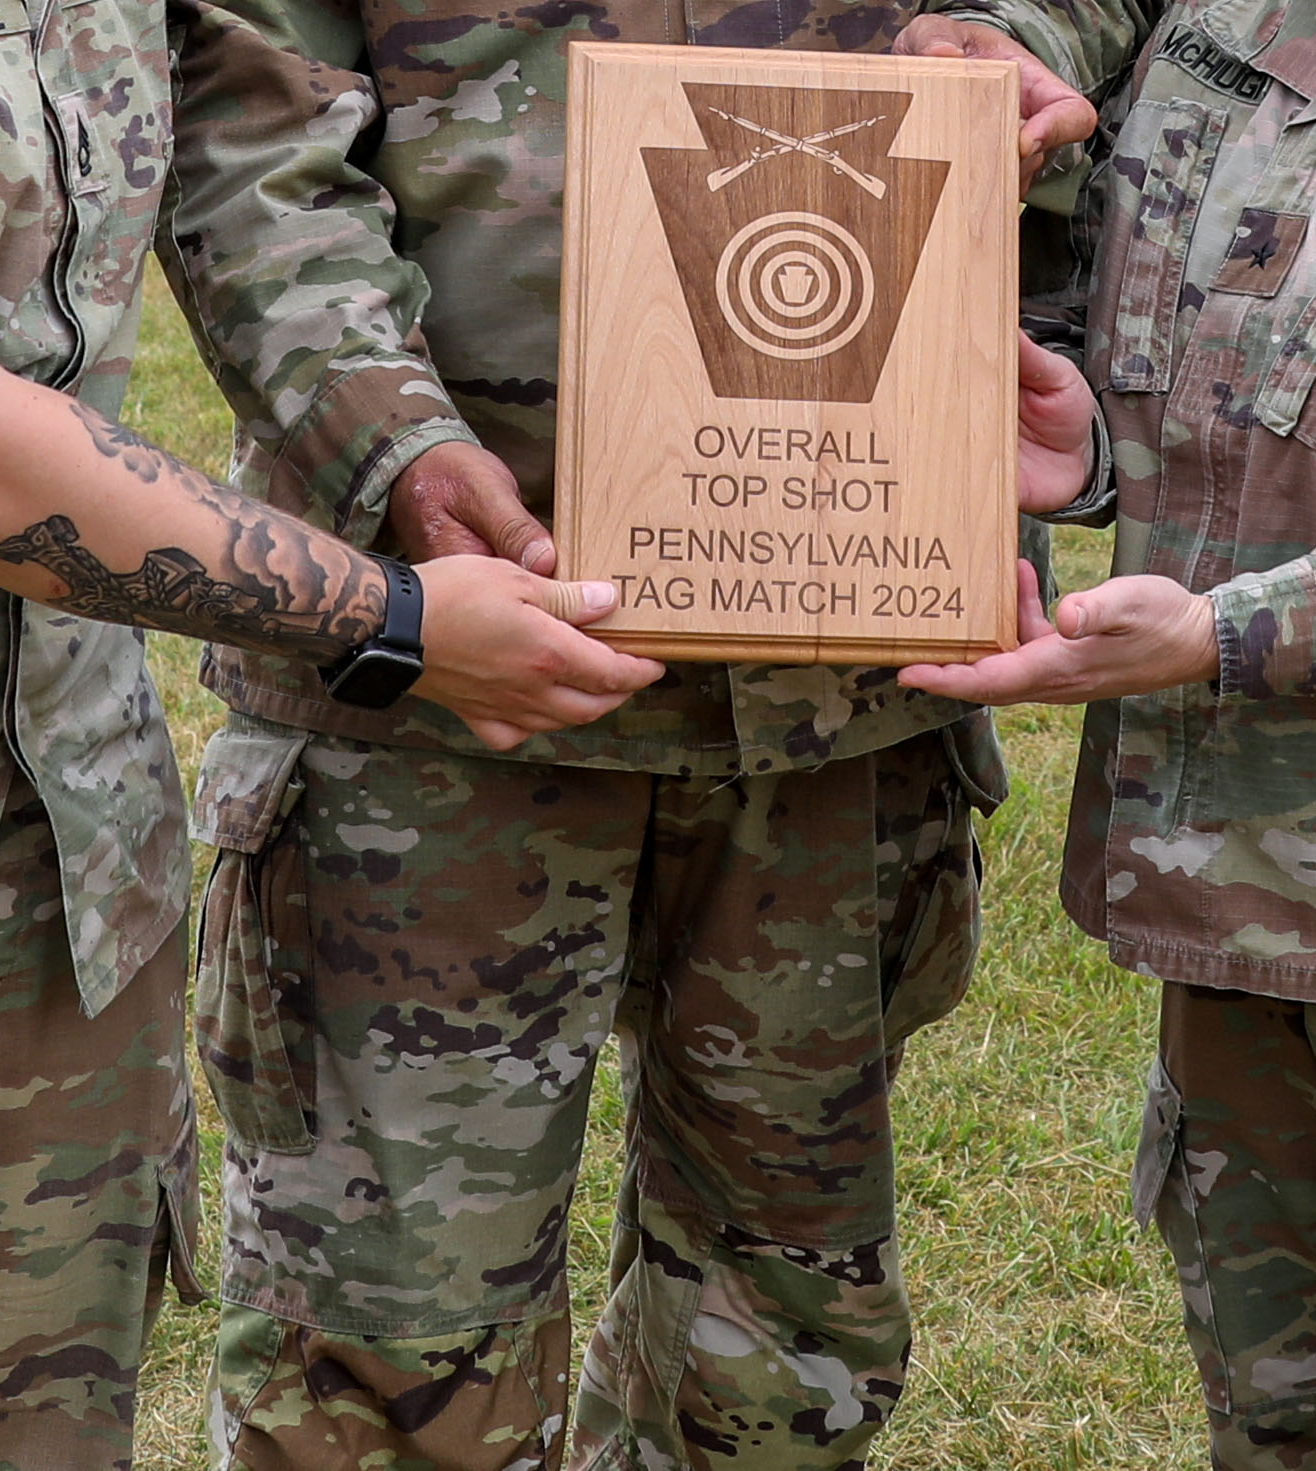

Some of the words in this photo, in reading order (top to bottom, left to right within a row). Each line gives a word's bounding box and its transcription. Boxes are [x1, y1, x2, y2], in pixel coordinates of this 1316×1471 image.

[694, 426, 890, 465] OVERALL
[682, 473, 768, 508] TOP
[782, 477, 899, 513] SHOT
[630, 527, 951, 570] PENNSYLVANIA
[611, 575, 695, 610] TAG
[711, 579, 857, 616] MATCH
[872, 584, 965, 619] 2024
